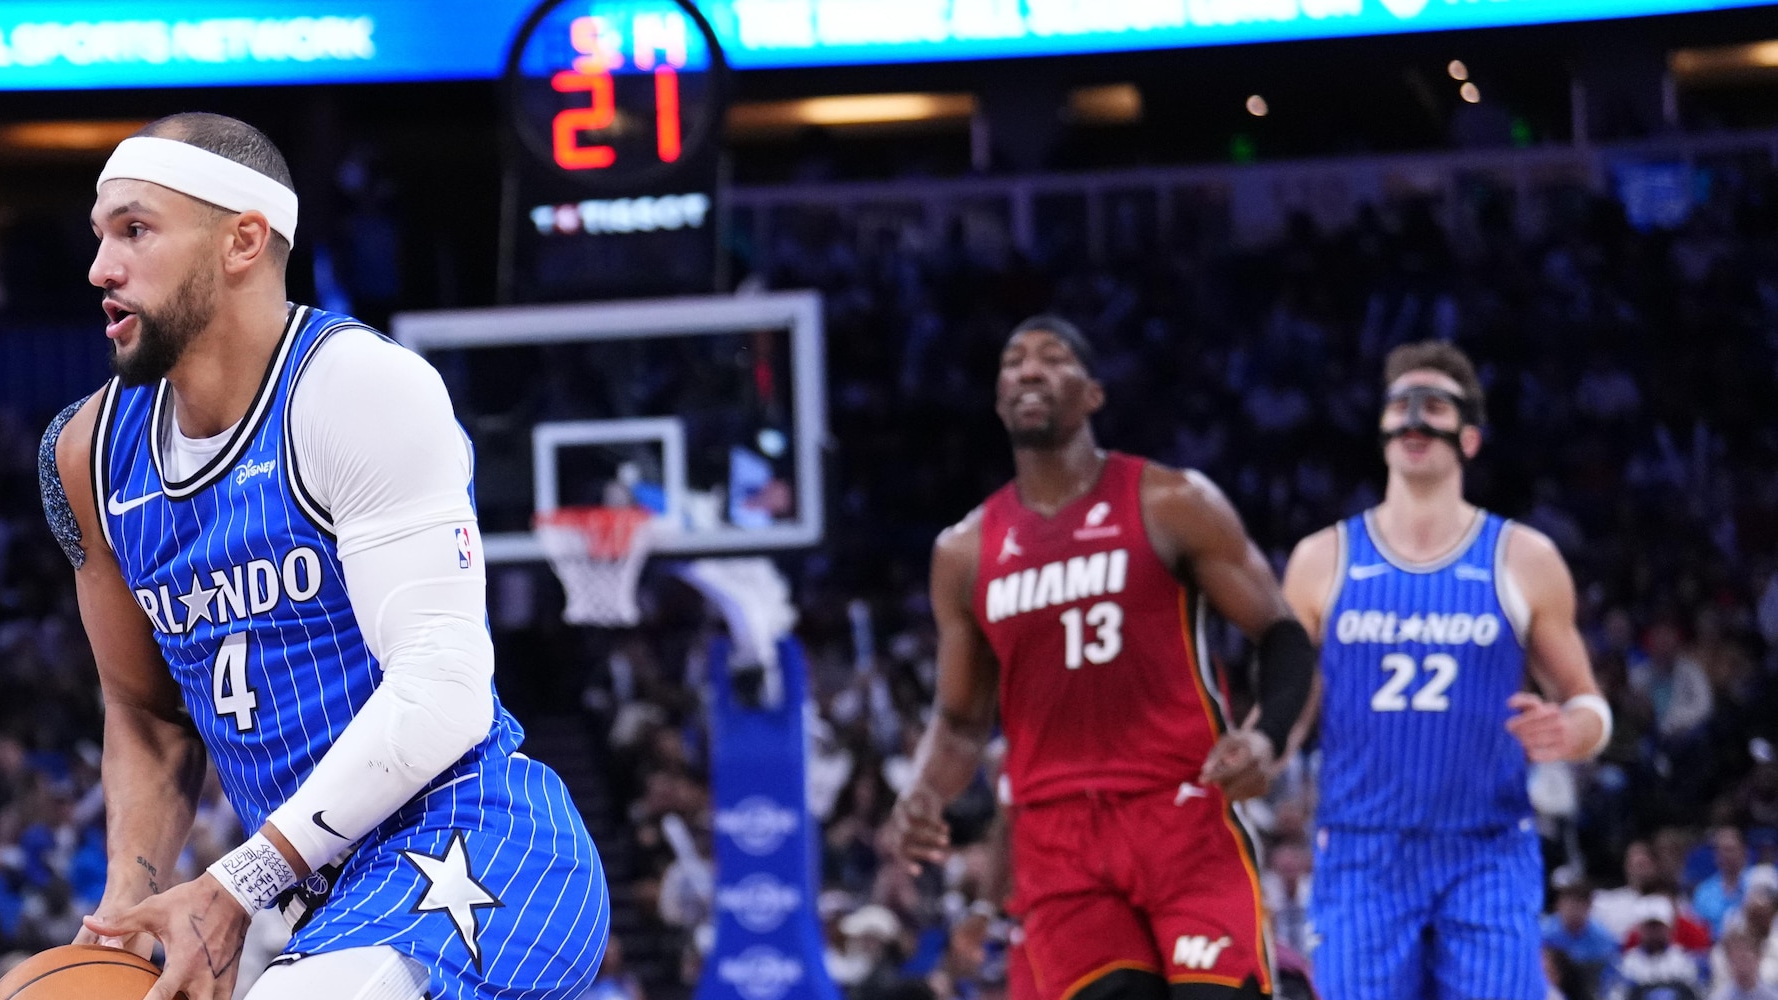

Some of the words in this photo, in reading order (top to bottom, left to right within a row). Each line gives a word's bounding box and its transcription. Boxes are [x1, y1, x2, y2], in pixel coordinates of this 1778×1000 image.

[12, 20, 170, 65] SPORTS
[172, 16, 376, 62] NETWORK
[551, 64, 681, 170] 21
[986, 549, 1128, 624] MIAMI
[1060, 601, 1124, 669] 13
[213, 630, 256, 732] 4
[1371, 652, 1459, 713] 22
